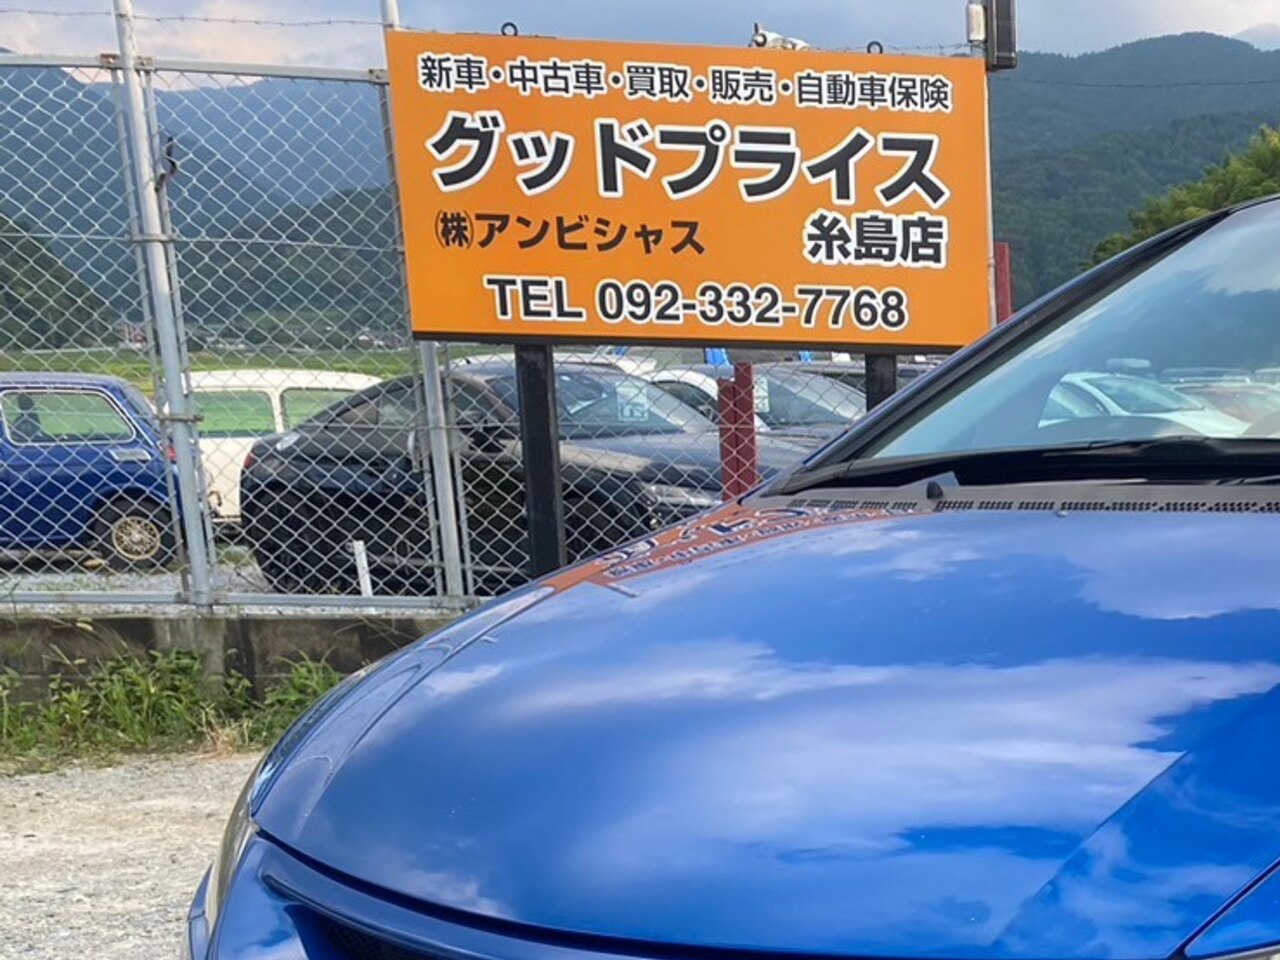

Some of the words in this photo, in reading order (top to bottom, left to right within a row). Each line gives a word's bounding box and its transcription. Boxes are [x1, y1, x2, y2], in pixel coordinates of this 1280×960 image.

[431, 113, 946, 203] グッドプライス
[807, 213, 944, 264] 糸島店
[487, 277, 583, 320] TEL
[599, 282, 906, 328] 092-332-7768
